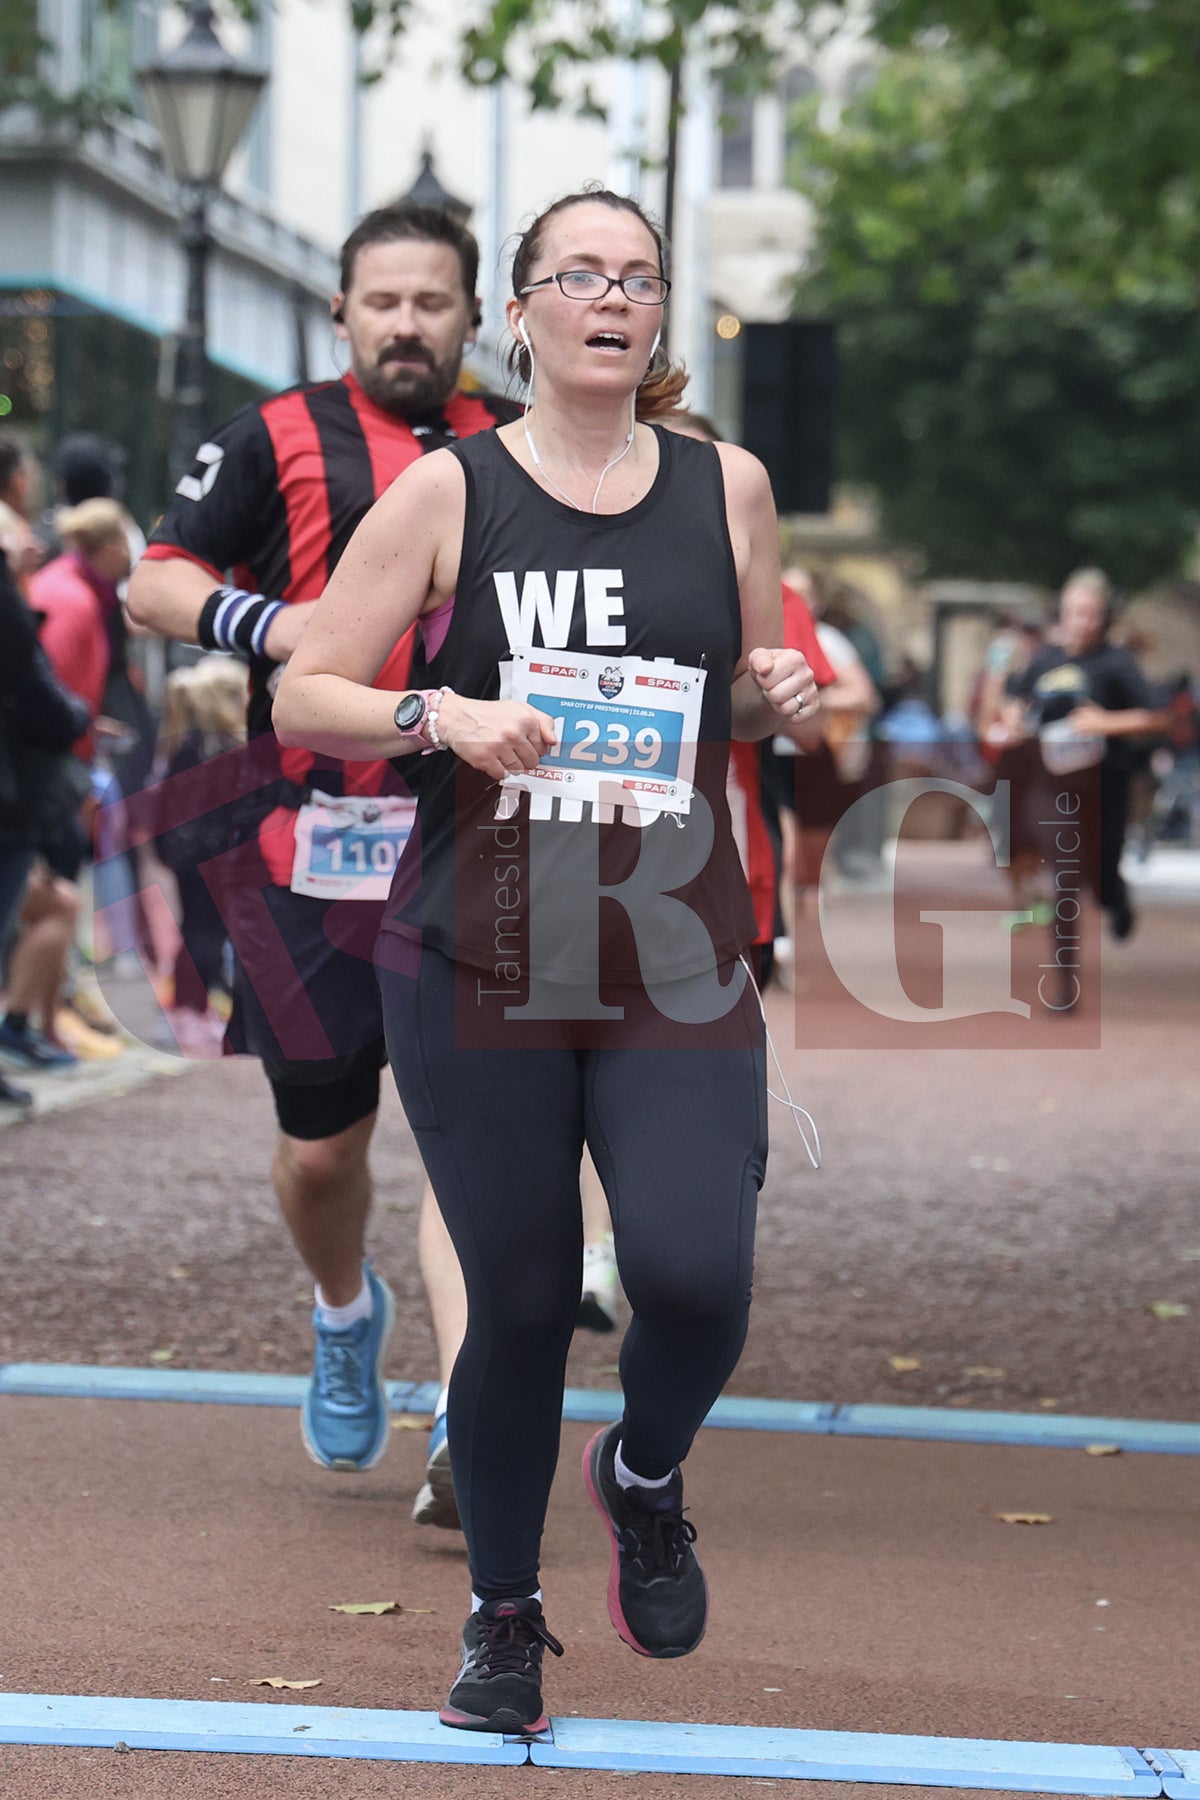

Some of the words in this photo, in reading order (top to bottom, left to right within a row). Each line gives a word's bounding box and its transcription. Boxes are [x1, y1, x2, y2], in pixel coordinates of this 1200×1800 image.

[493, 569, 626, 648] WE
[542, 666, 578, 677] SPAR
[647, 678, 681, 690] SPAR
[549, 716, 662, 769] 1239
[528, 768, 563, 780] SPAR
[634, 782, 668, 794] SPAR
